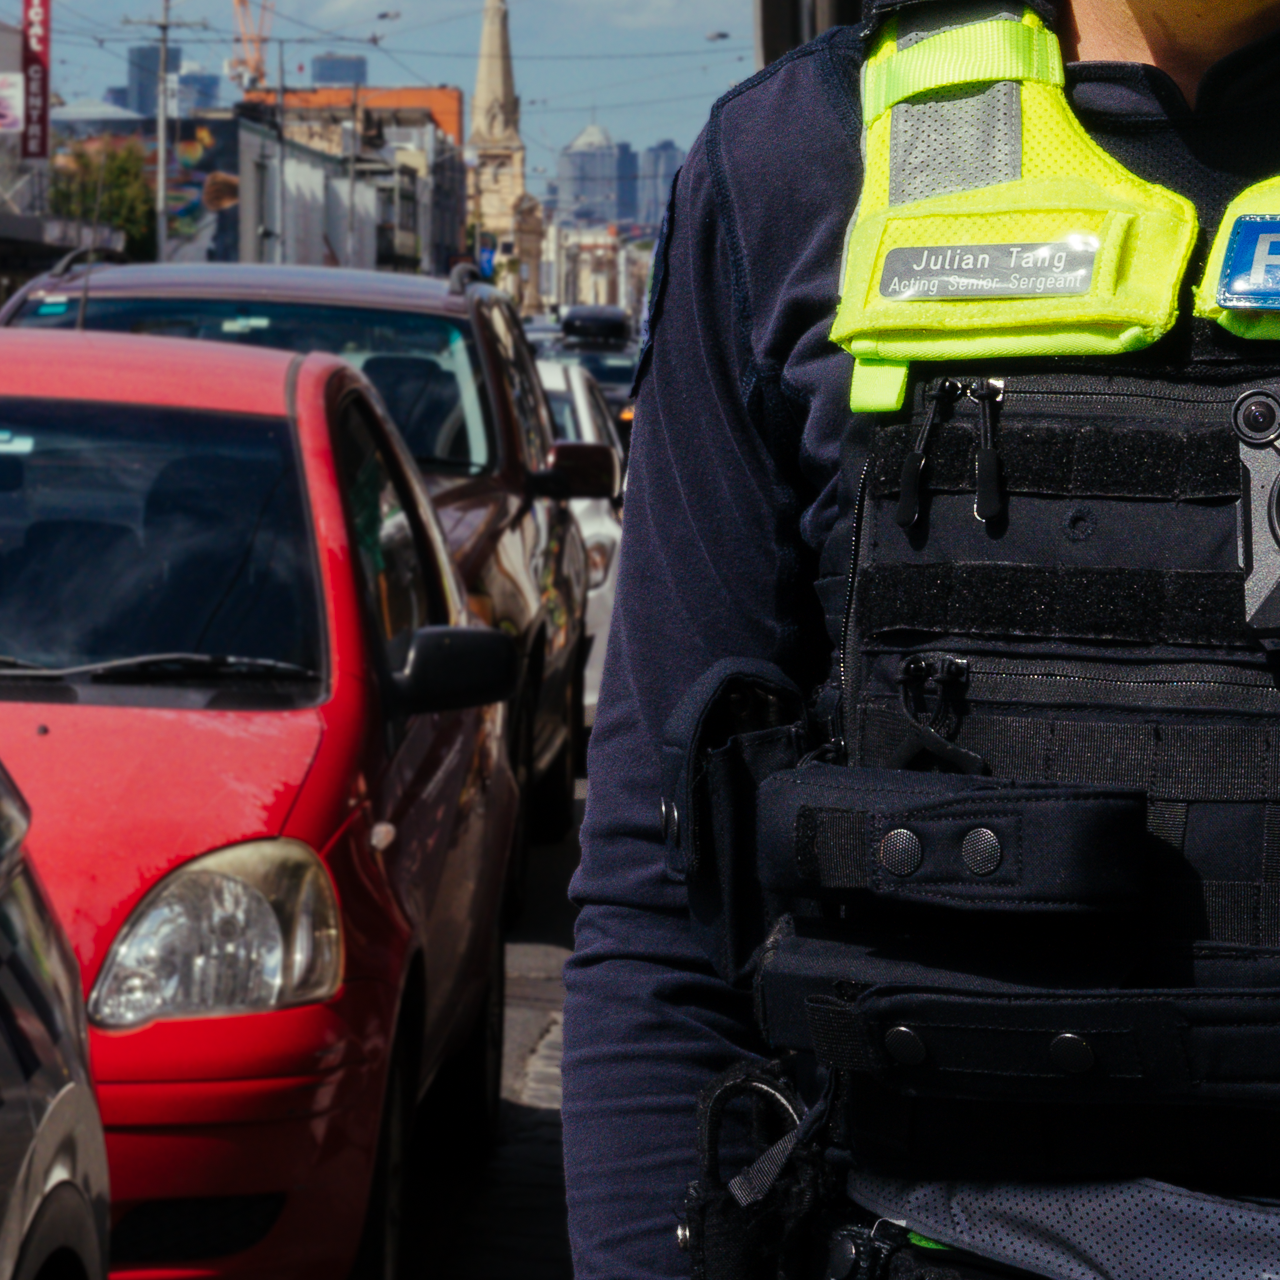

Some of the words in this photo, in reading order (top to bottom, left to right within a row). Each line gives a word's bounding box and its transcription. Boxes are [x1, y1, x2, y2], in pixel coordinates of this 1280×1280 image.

[27, 65, 44, 153] CENTRE
[912, 249, 990, 271] Julian
[1009, 247, 1067, 272] Tang
[888, 275, 939, 295] Acting
[948, 274, 1000, 291] Senior
[1009, 272, 1082, 293] Sergeant
